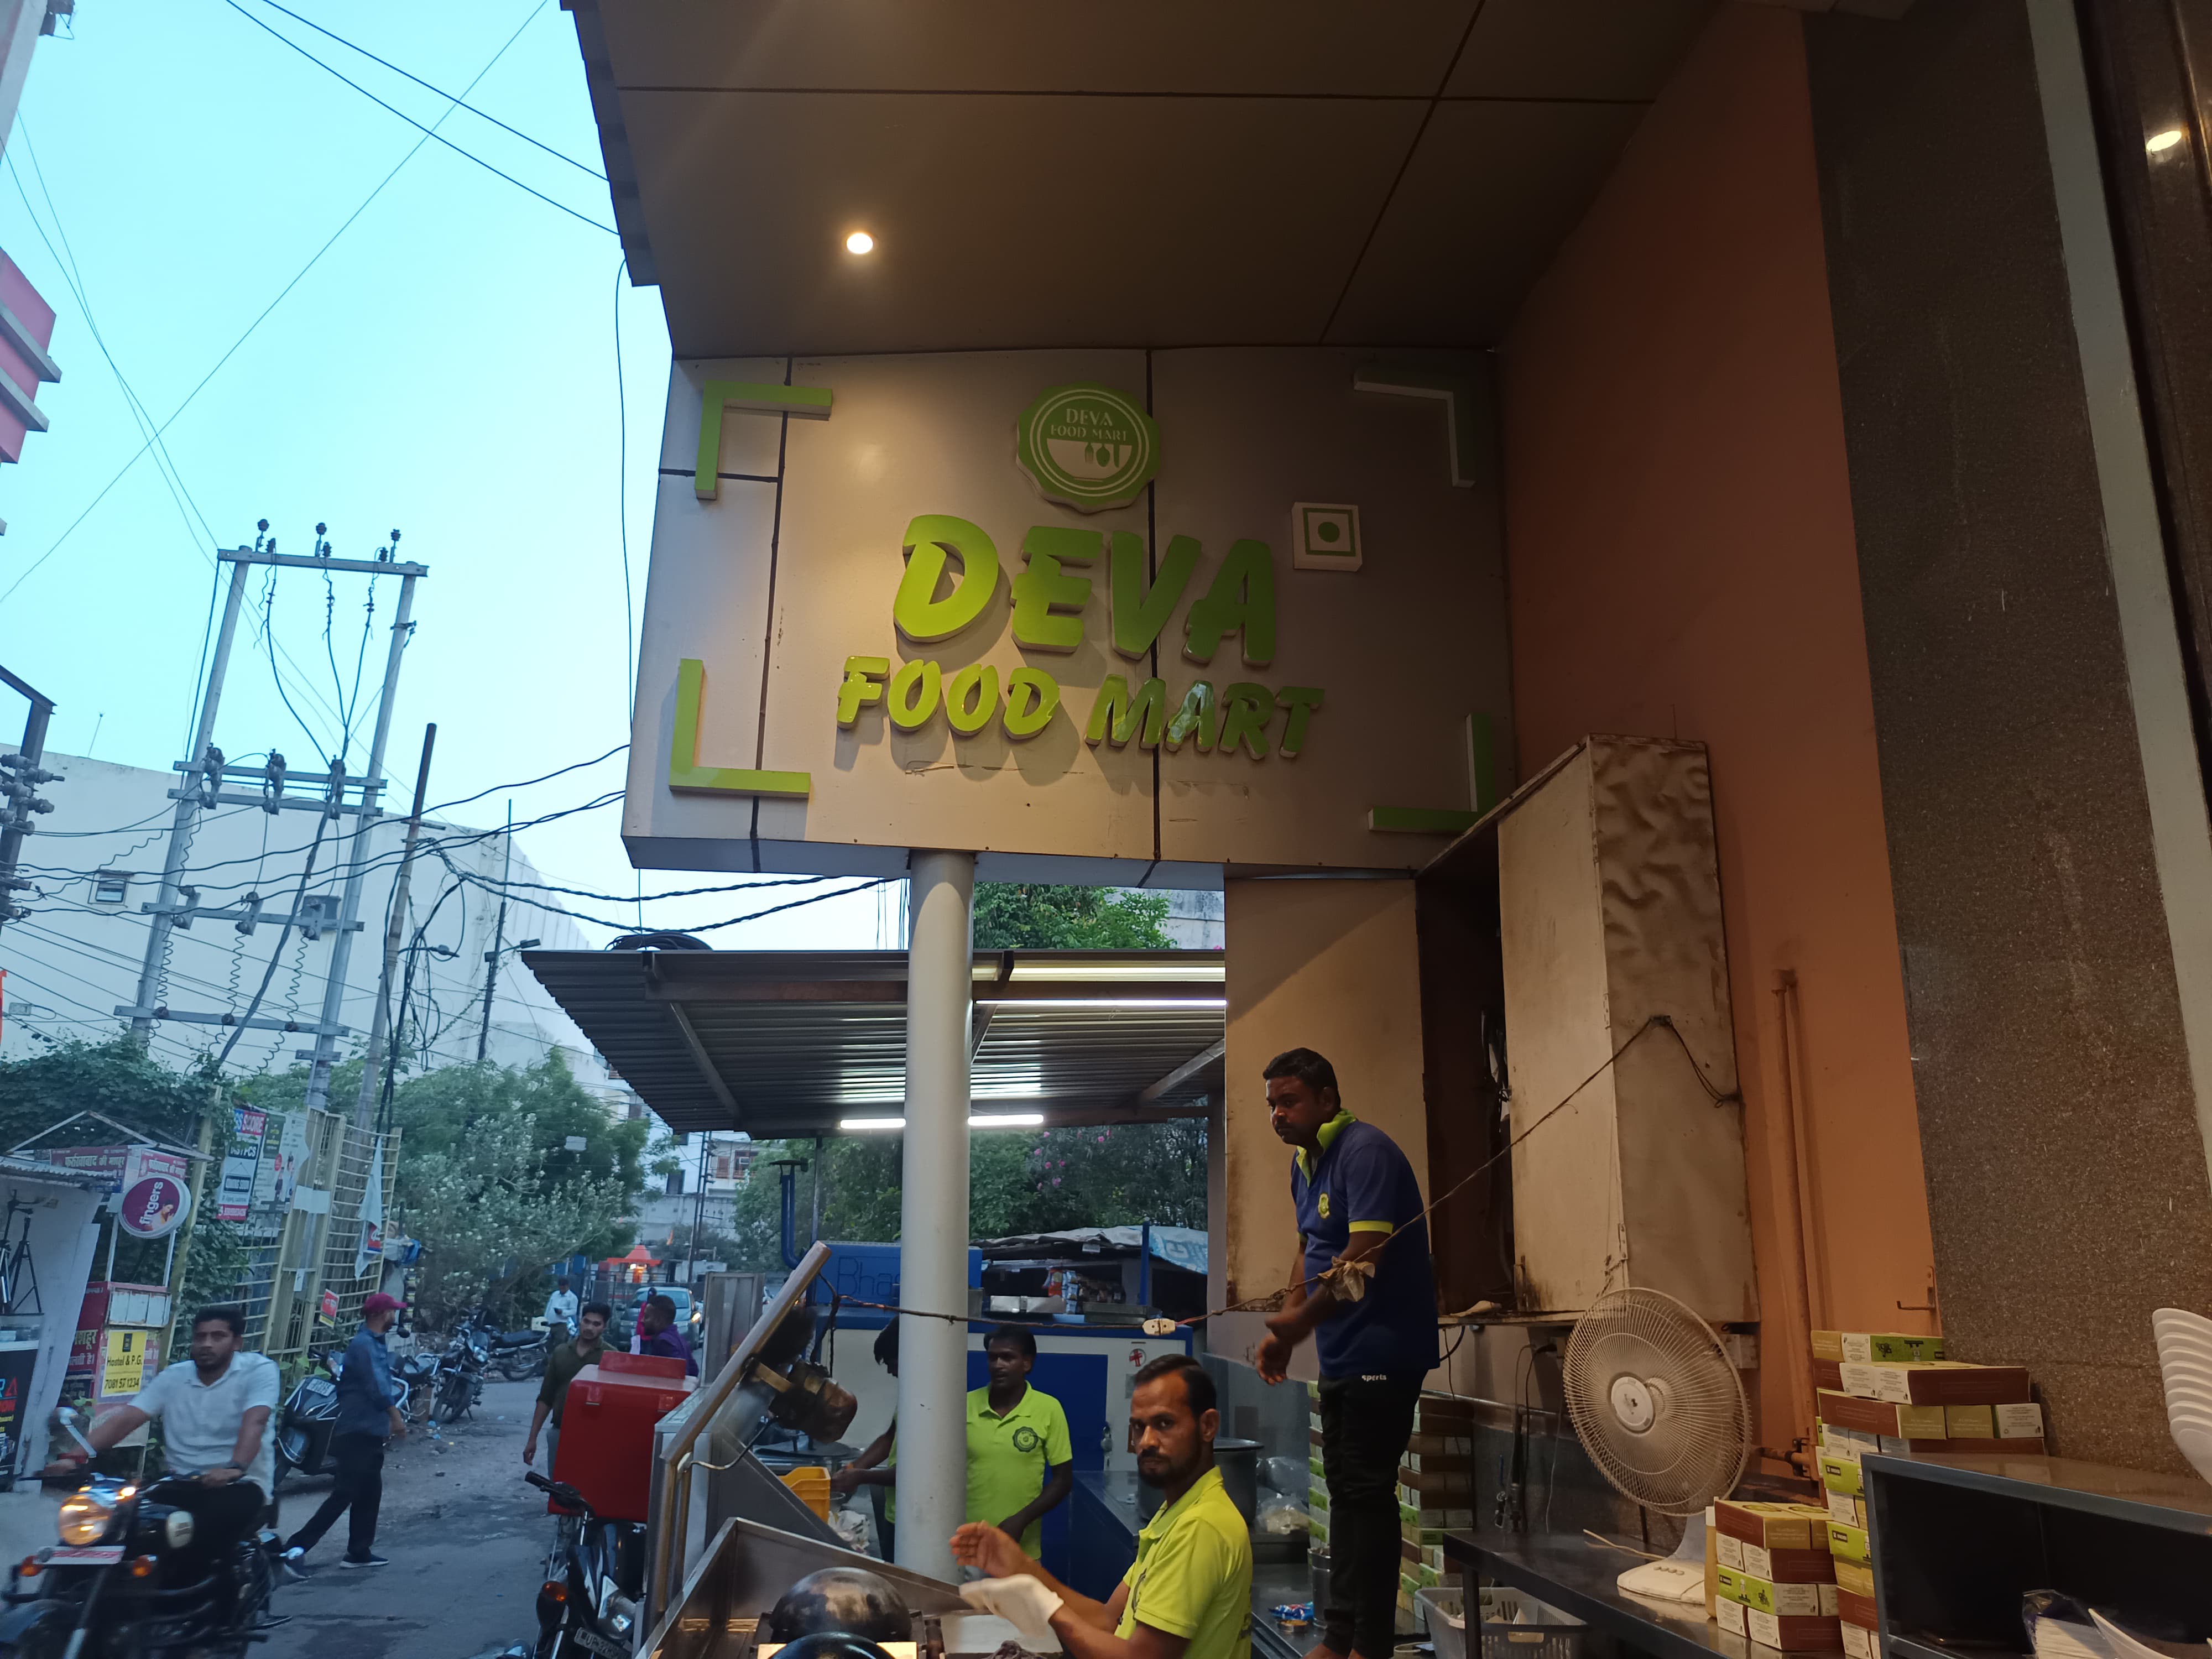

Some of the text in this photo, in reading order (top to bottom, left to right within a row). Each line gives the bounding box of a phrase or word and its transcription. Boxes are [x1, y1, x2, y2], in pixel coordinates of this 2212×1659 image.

[1066, 408, 1113, 426] DEVA
[1051, 425, 1126, 441] FOOD MART
[893, 514, 1276, 666] DEVA
[837, 656, 1326, 761] FOOD MART
[139, 1181, 164, 1225] fingers
[107, 1355, 124, 1366] Hostel
[126, 1354, 130, 1365] &
